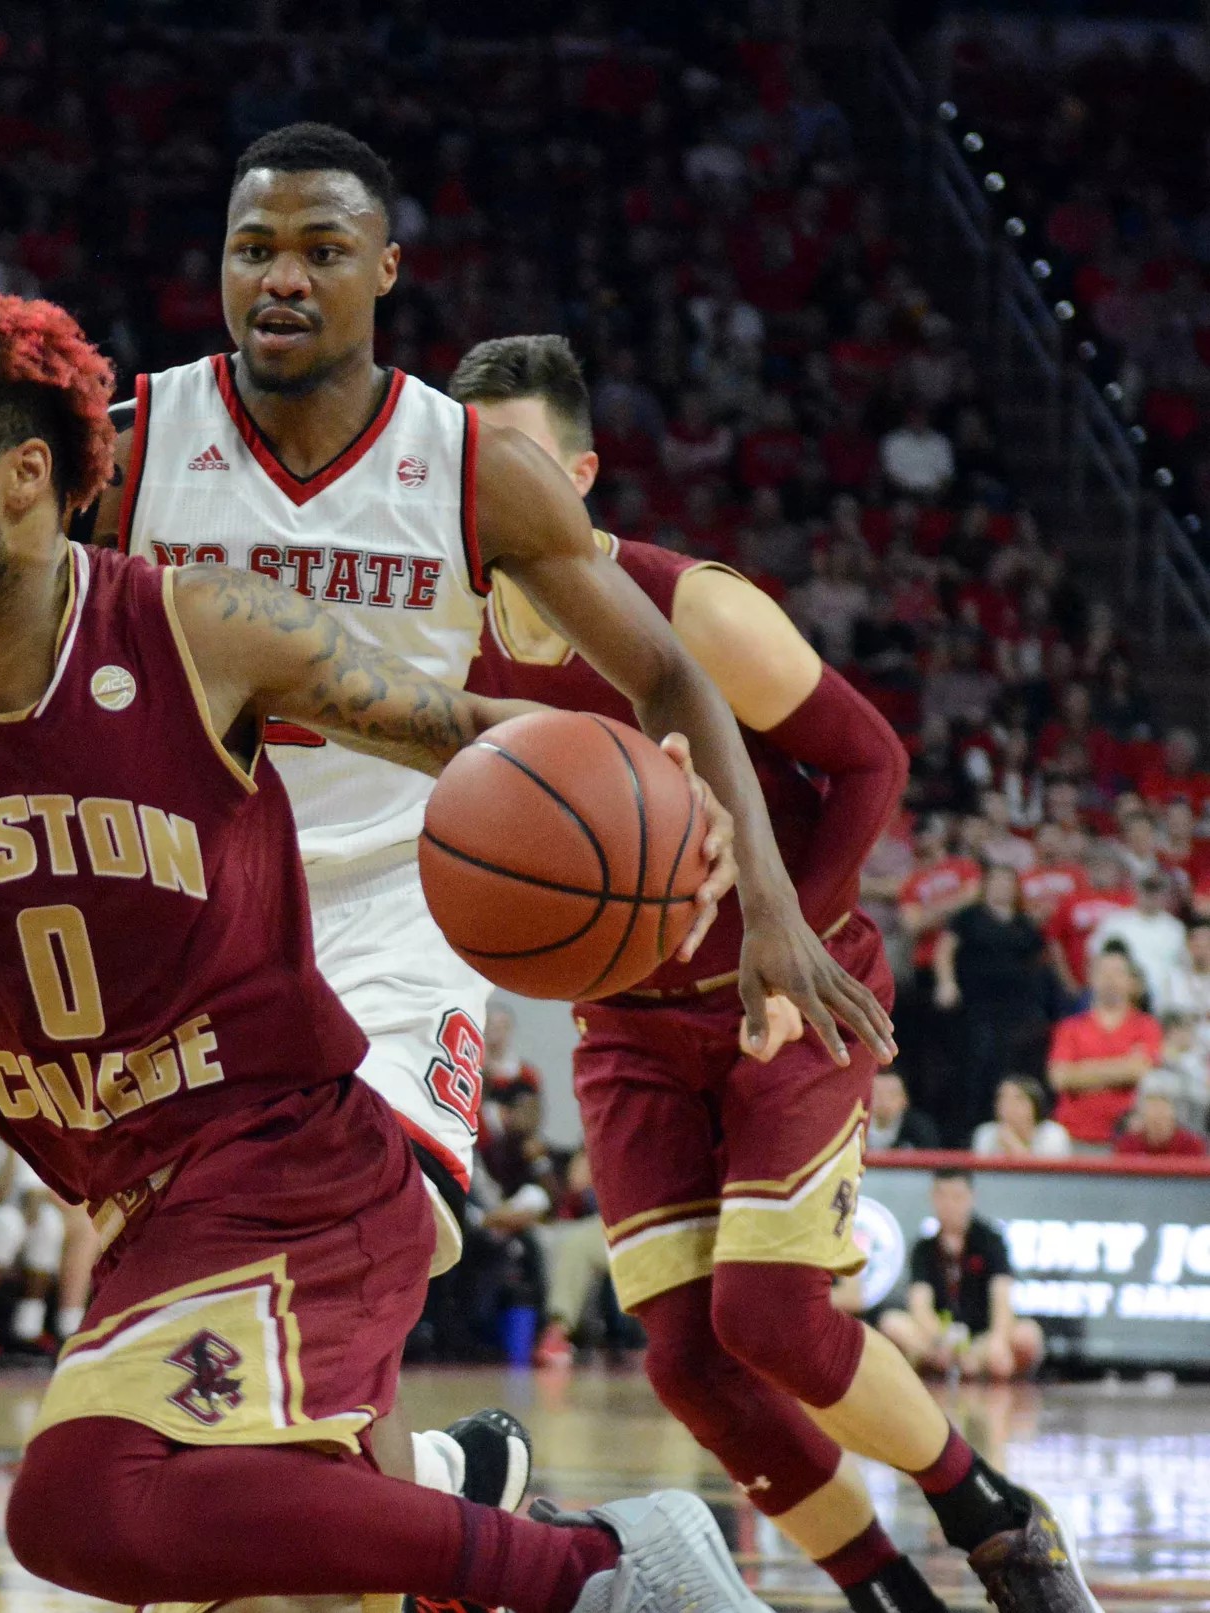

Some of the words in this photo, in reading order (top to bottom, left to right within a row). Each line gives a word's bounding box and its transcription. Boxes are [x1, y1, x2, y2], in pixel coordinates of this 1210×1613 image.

[187, 459, 230, 471] adidas
[247, 543, 443, 609] STATE
[16, 904, 106, 1041] 0
